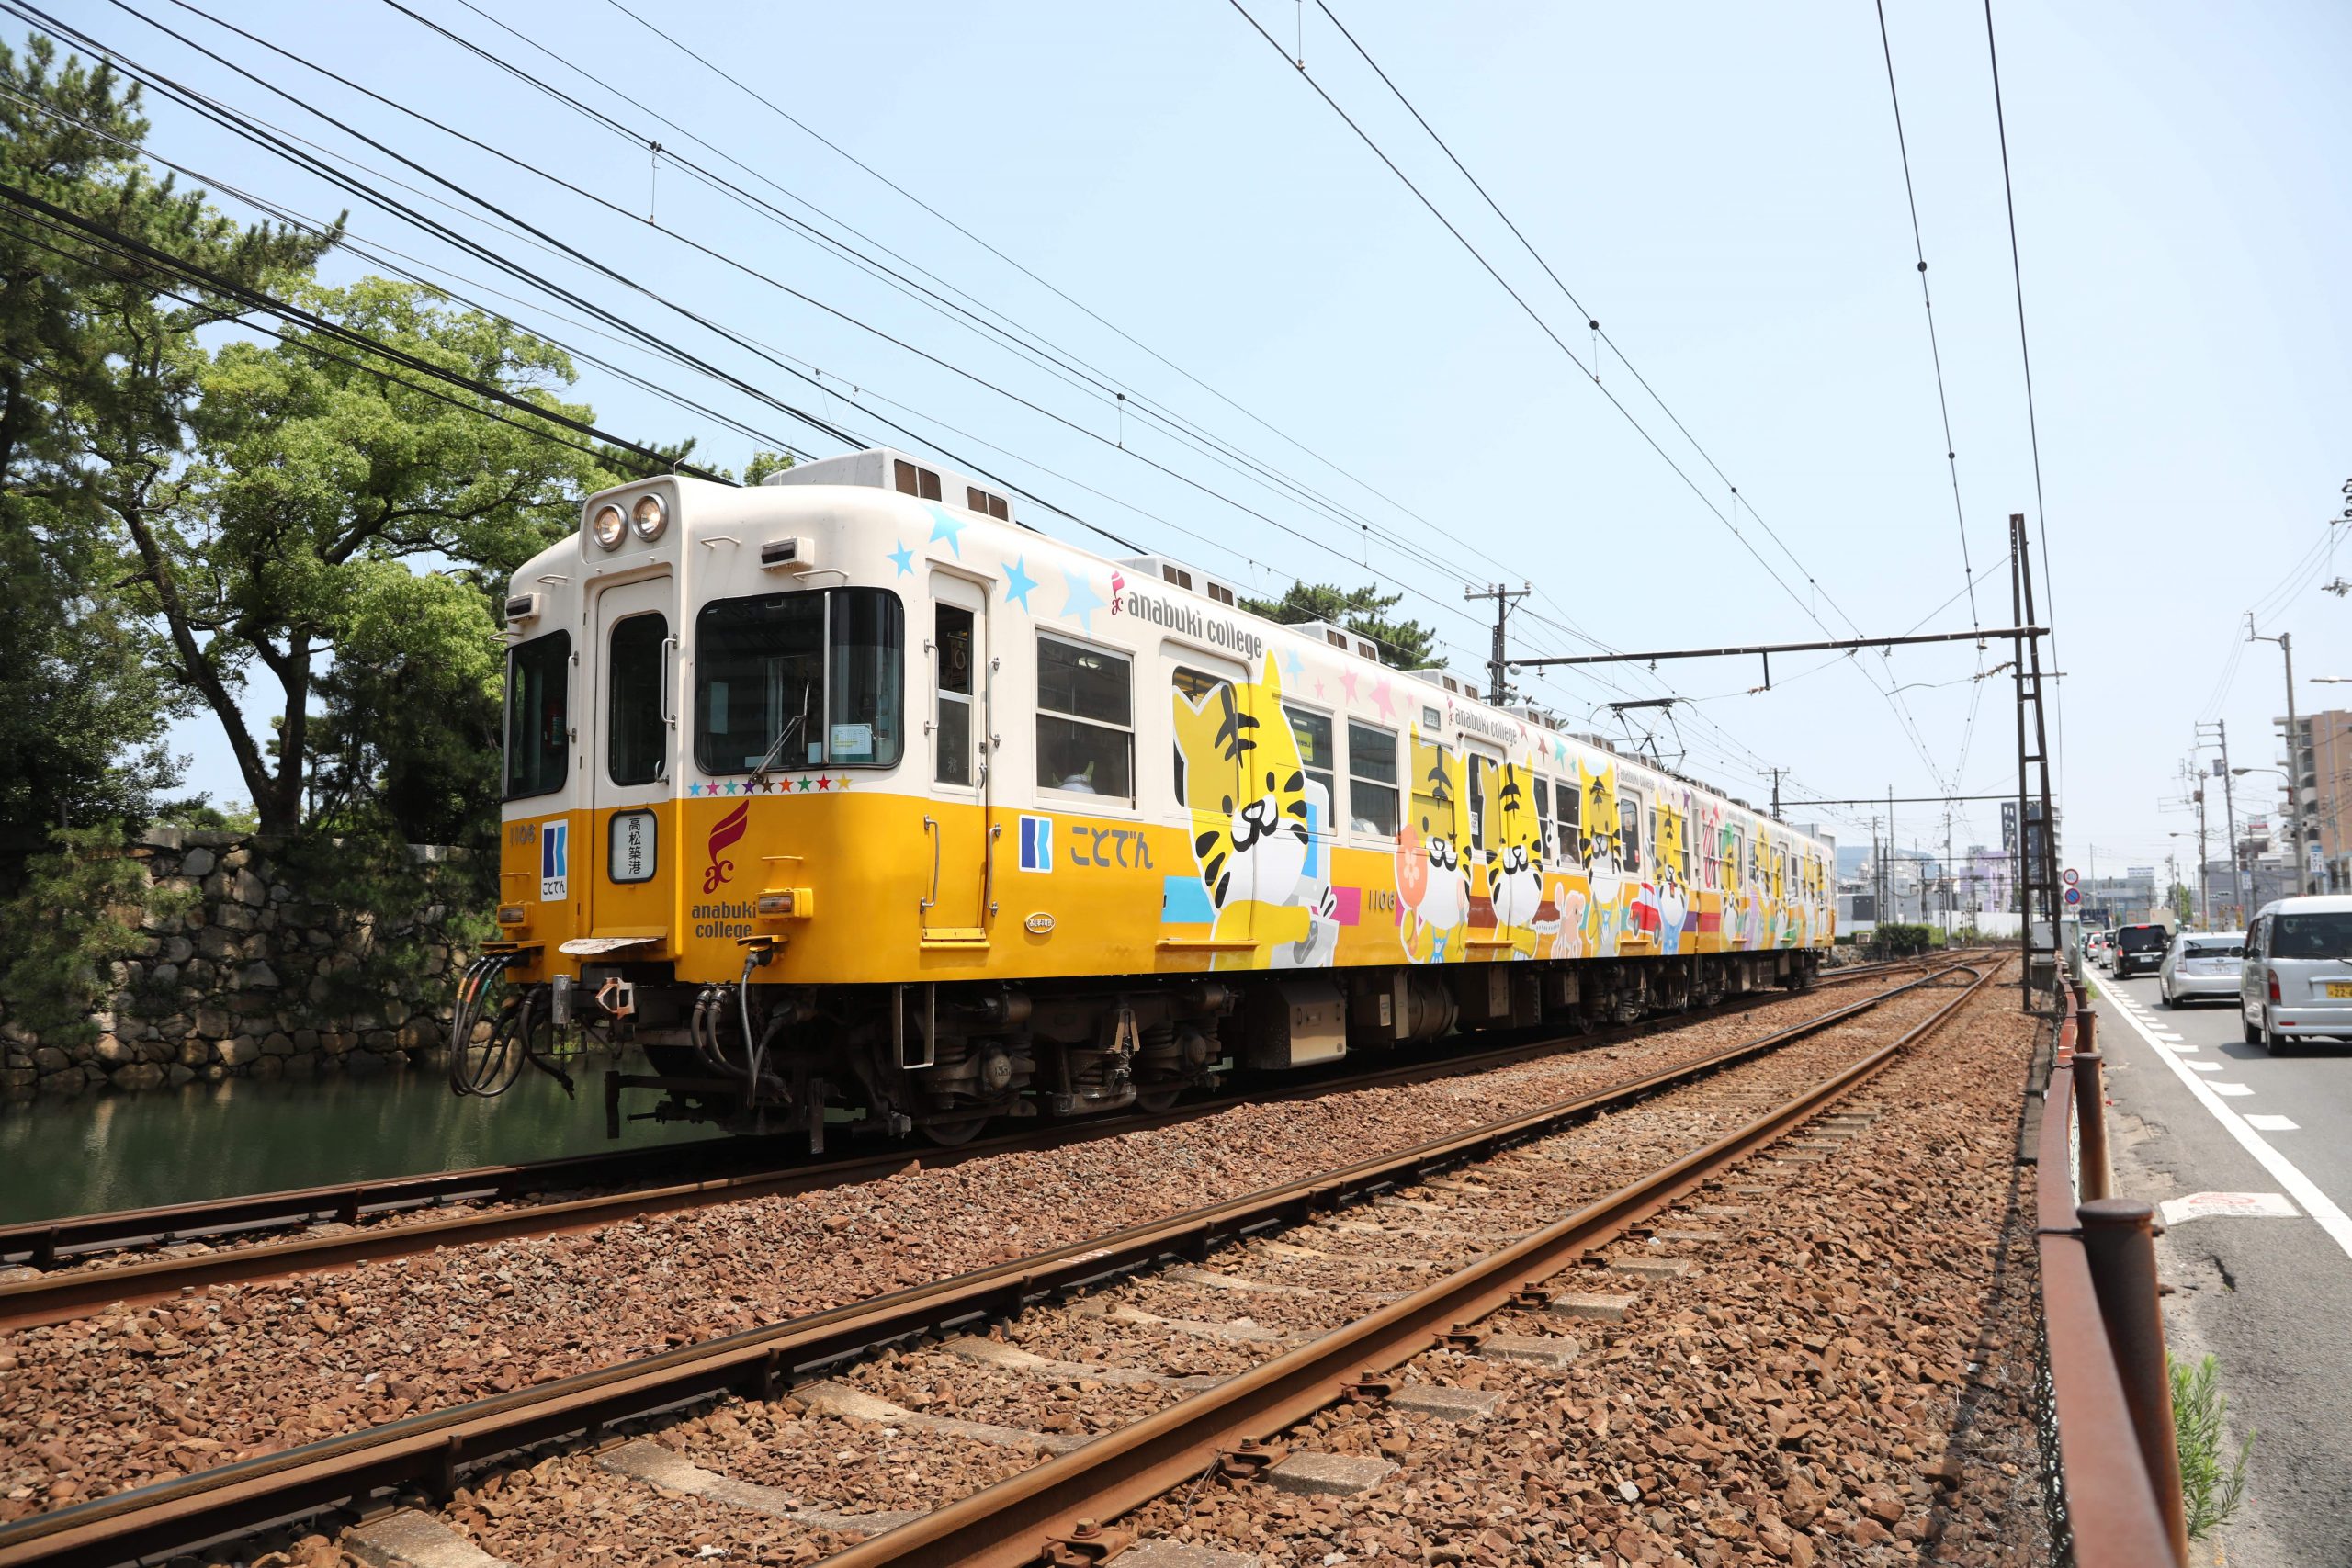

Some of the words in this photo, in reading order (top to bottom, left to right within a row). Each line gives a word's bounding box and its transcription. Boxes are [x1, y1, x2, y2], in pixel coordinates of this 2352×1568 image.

[1128, 591, 1203, 638] anabuki
[1207, 618, 1261, 660] college
[1455, 707, 1488, 735] anabuki
[1490, 721, 1517, 746] college
[509, 823, 536, 847] 1106
[628, 817, 641, 874] 高松築港
[1070, 826, 1154, 869] ことでん
[542, 880, 566, 896] ことでん
[691, 901, 757, 919] anabuki
[1368, 889, 1396, 912] 1106
[695, 921, 752, 939] college
